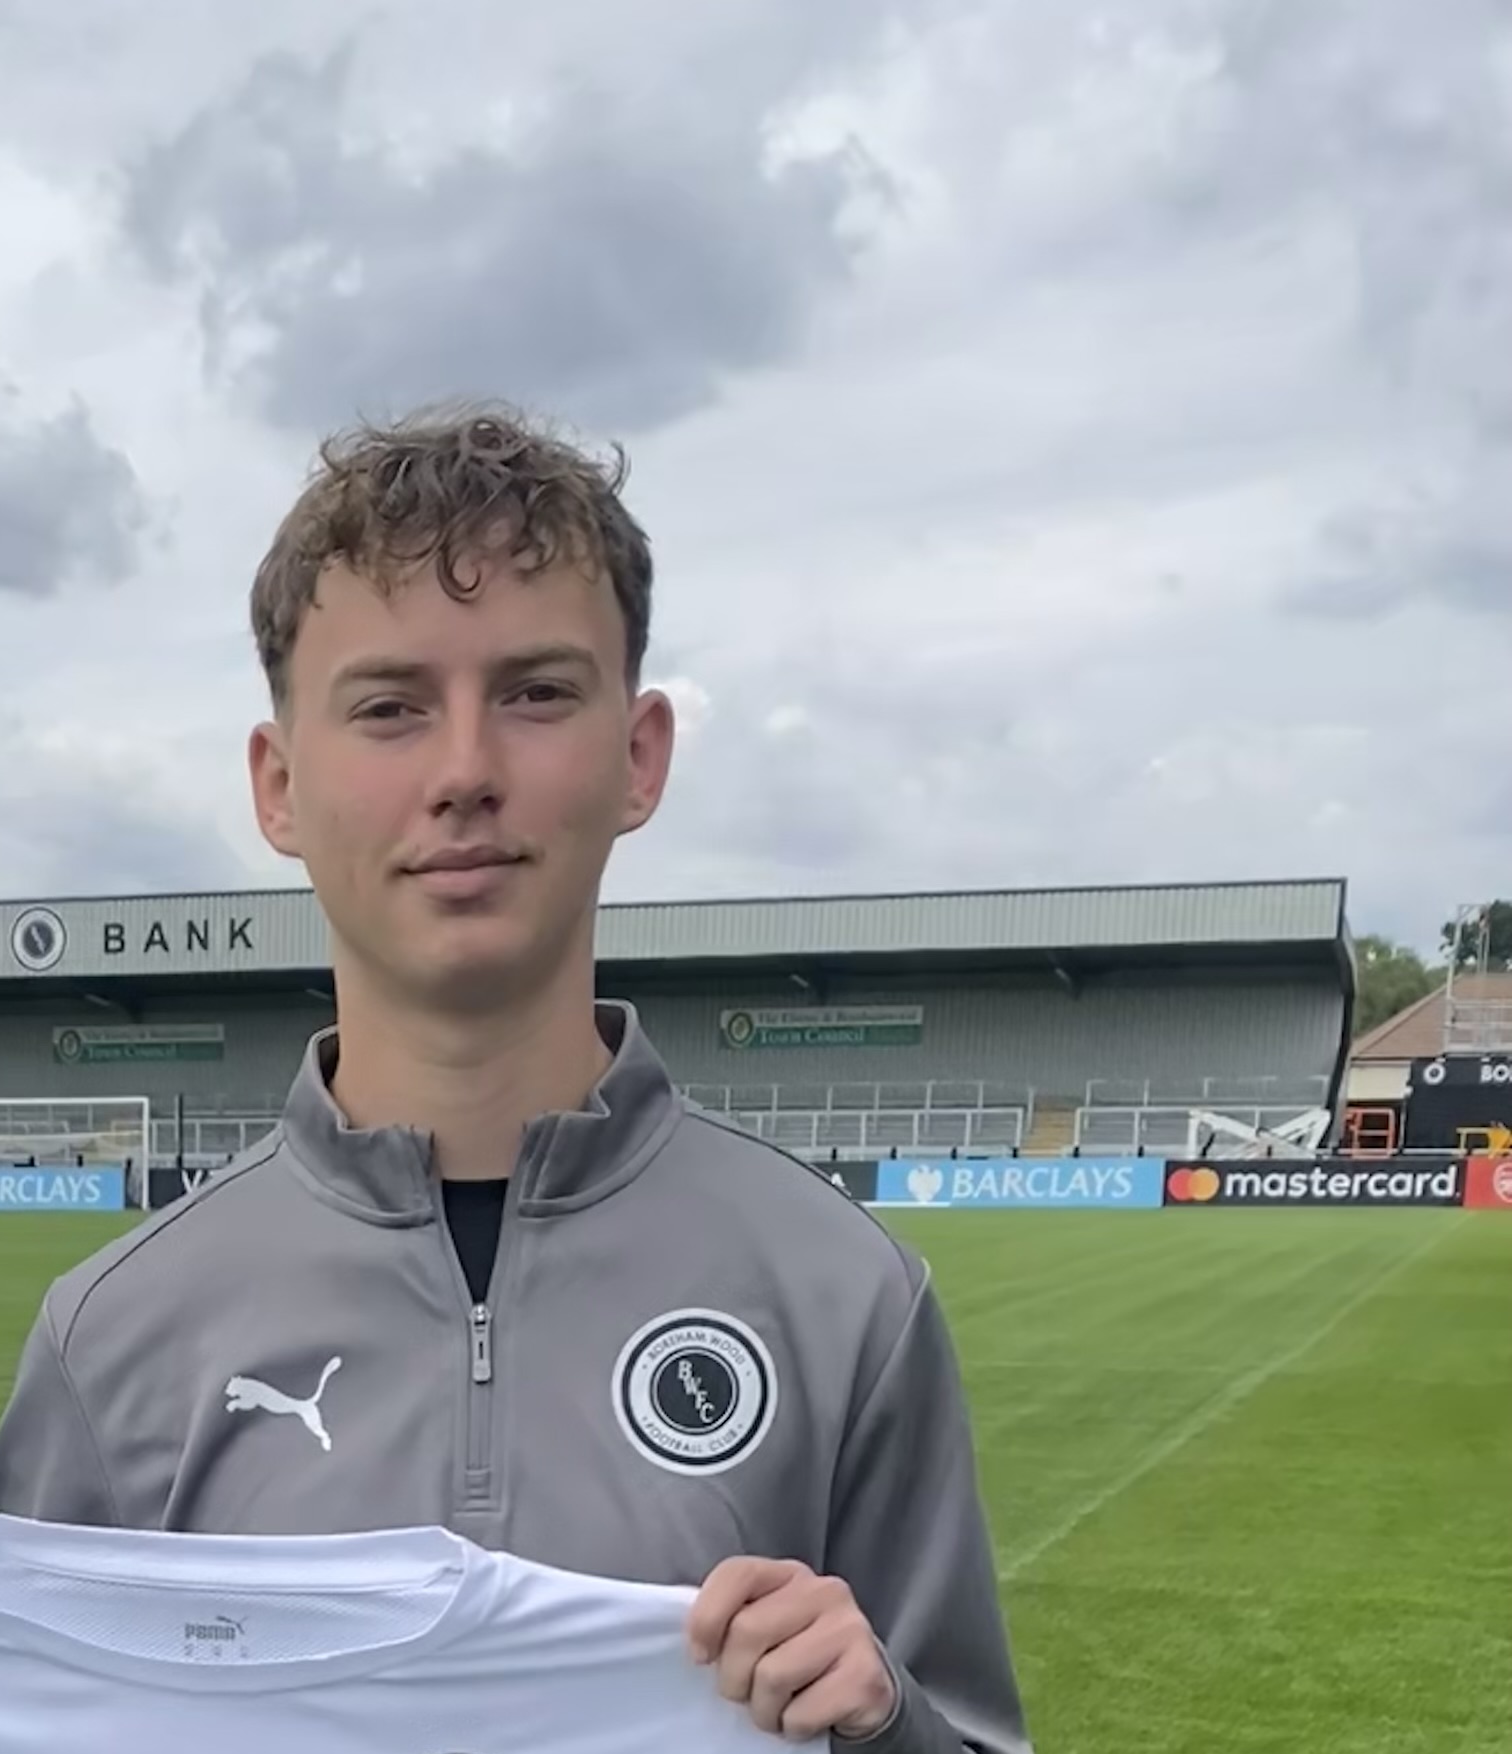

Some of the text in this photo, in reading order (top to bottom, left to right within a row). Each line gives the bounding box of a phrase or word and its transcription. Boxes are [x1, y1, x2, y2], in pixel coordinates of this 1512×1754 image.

[103, 917, 254, 954] BANK
[951, 1166, 1133, 1200] BARCLAYS
[709, 1335, 746, 1366] WOOD
[708, 1428, 739, 1453] CLUB
